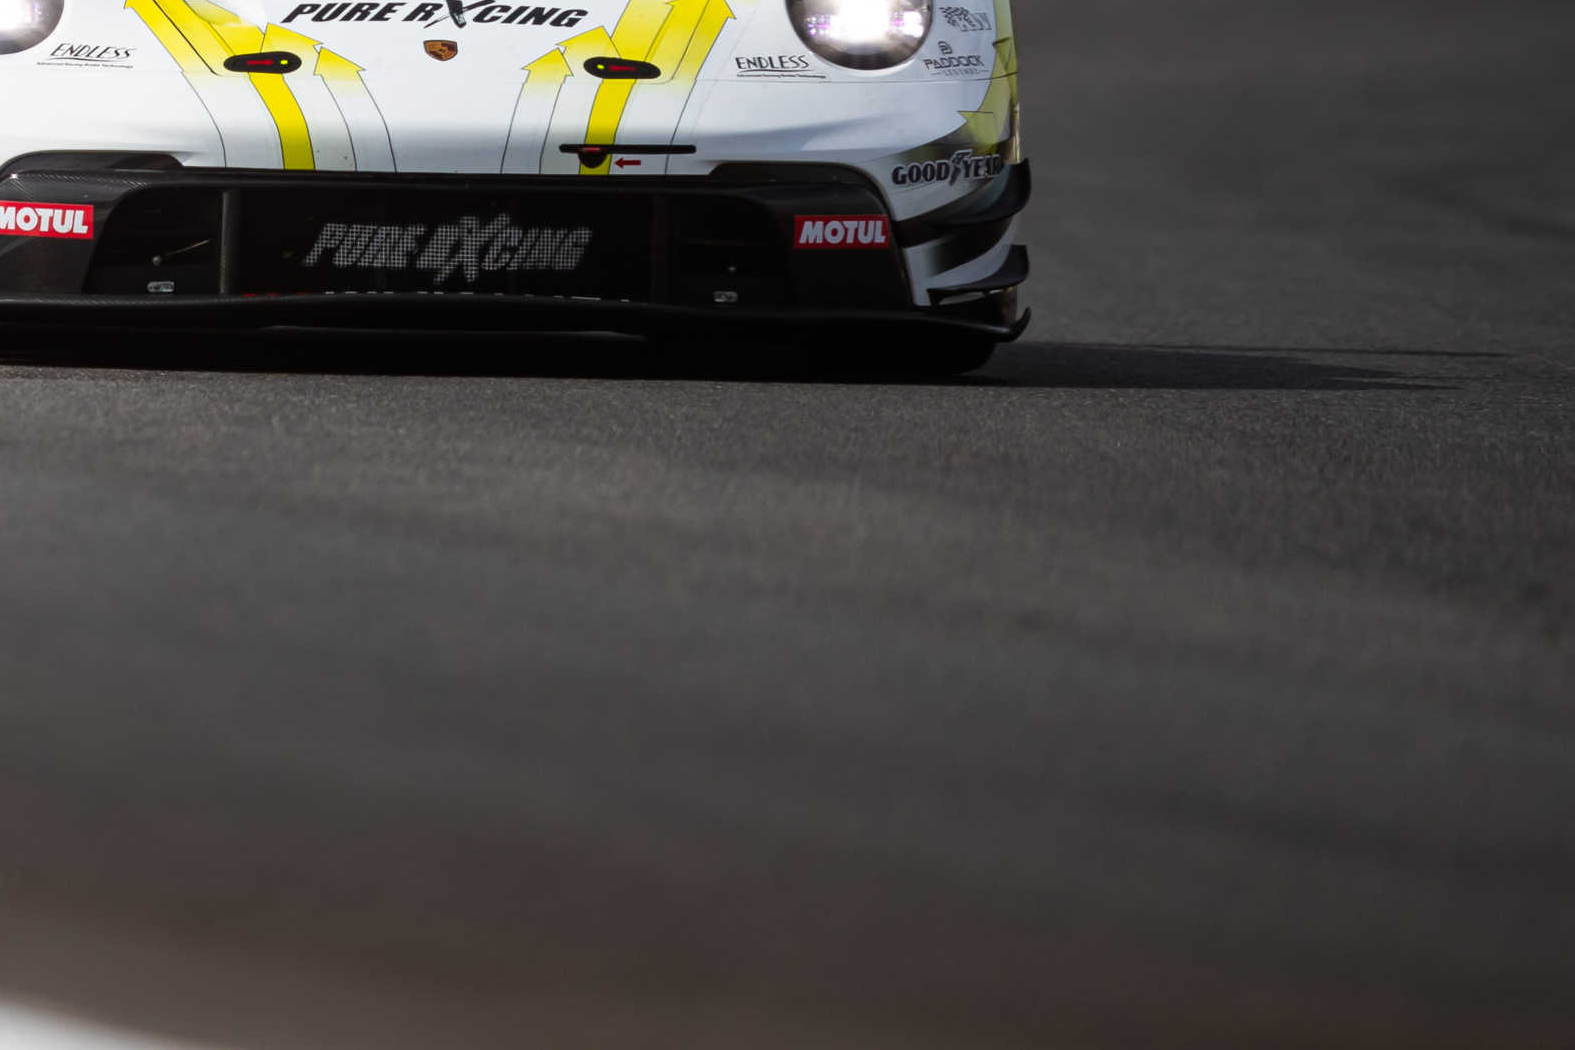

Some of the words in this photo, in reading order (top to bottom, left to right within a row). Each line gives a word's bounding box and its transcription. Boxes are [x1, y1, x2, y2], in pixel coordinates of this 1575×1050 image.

[280, 2, 408, 24] PURE
[50, 43, 136, 59] ENDLESS
[735, 54, 809, 69] ENDLESS
[923, 55, 984, 70] PADDOCK
[798, 220, 886, 244] MOTUL
[303, 223, 426, 267] PURE
